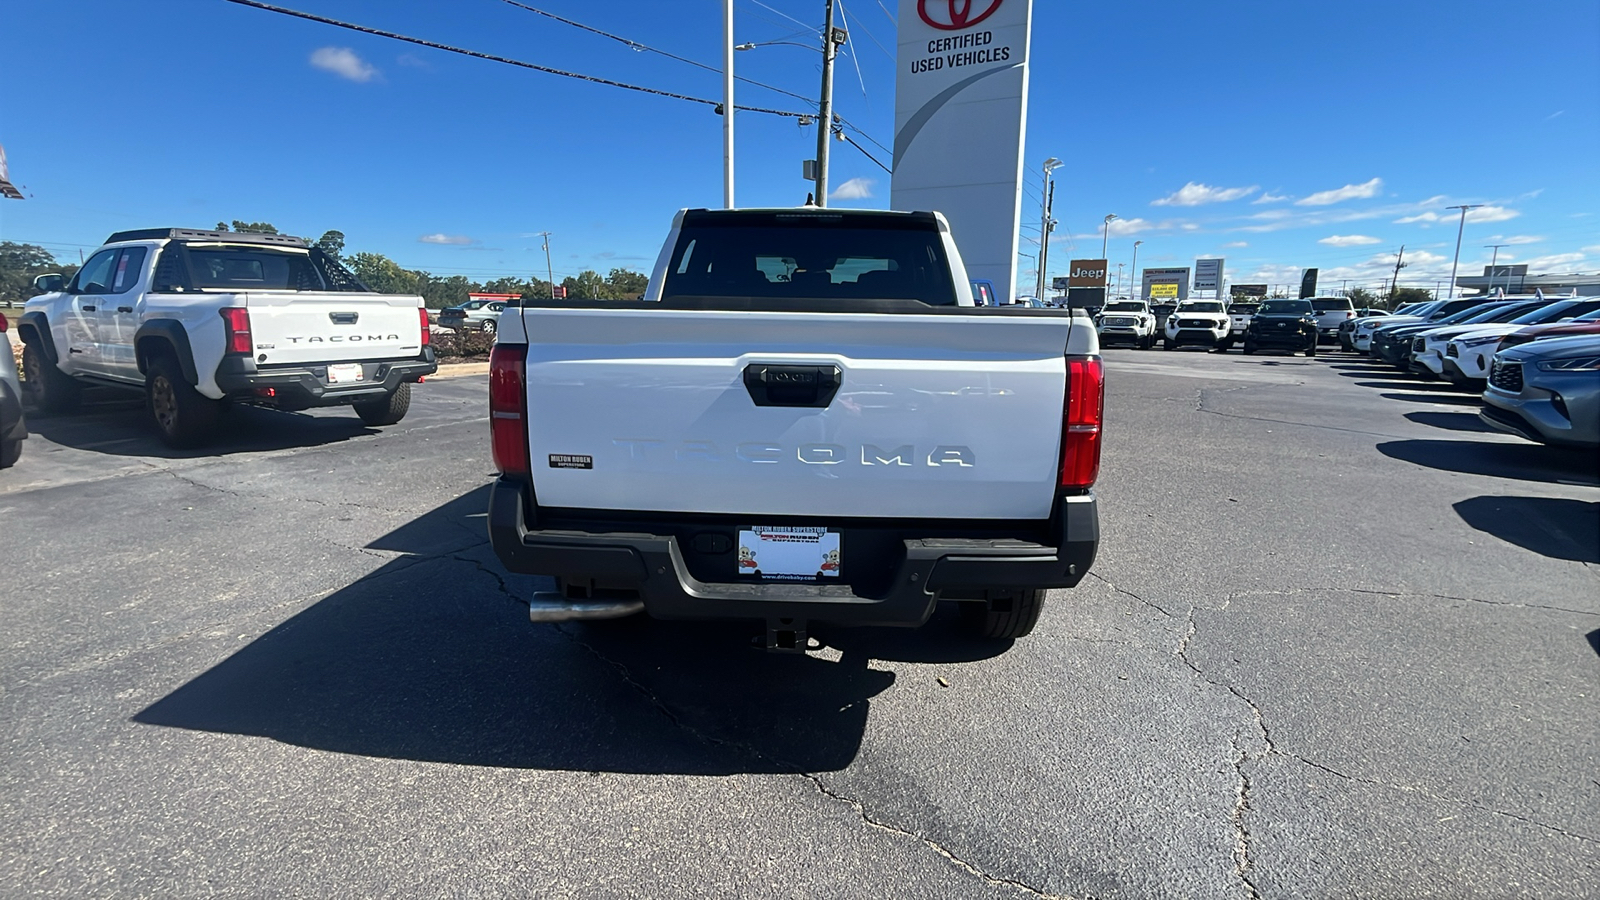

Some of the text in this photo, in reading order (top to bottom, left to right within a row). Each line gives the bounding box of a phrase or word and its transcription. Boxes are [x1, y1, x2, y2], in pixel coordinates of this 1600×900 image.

[928, 31, 992, 53] CERTIFIED
[911, 46, 1010, 74] USED VEHICLES
[1072, 268, 1104, 279] Jeep
[286, 334, 399, 343] TACOMA
[769, 371, 814, 382] TOYOTA
[611, 438, 976, 468] TACOMA
